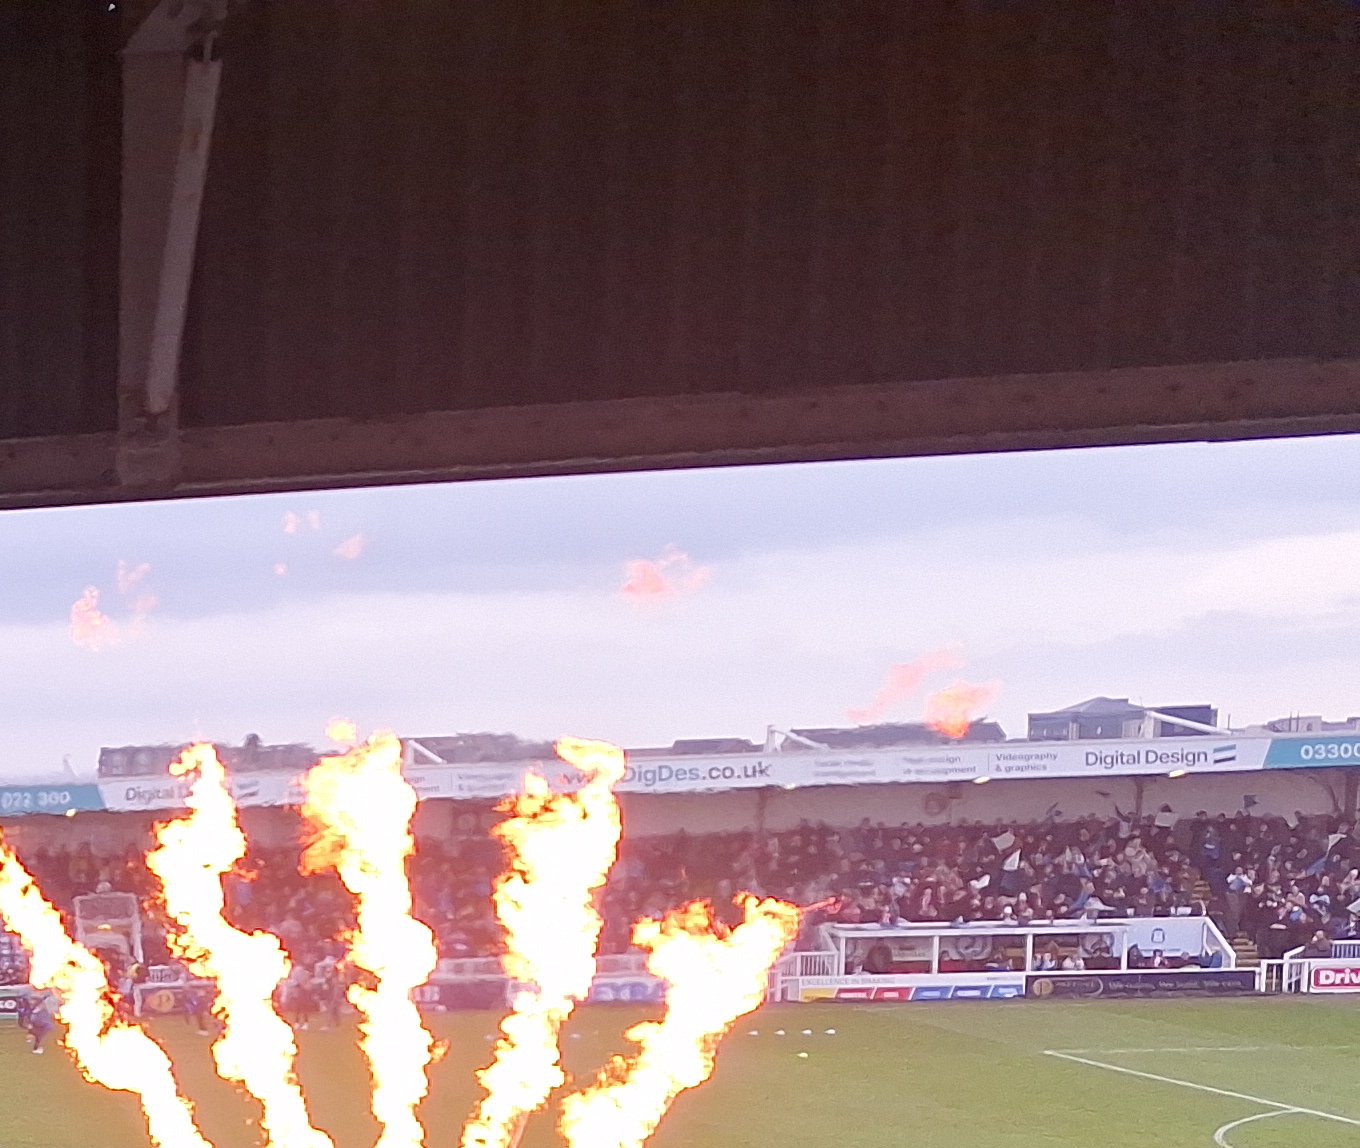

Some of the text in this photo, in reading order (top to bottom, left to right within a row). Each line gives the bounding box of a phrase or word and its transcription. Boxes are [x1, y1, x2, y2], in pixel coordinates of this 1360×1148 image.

[995, 752, 1059, 762] Videography
[1085, 748, 1208, 769] Digital Design
[1004, 763, 1048, 773] graphics
[125, 785, 175, 803] Digital
